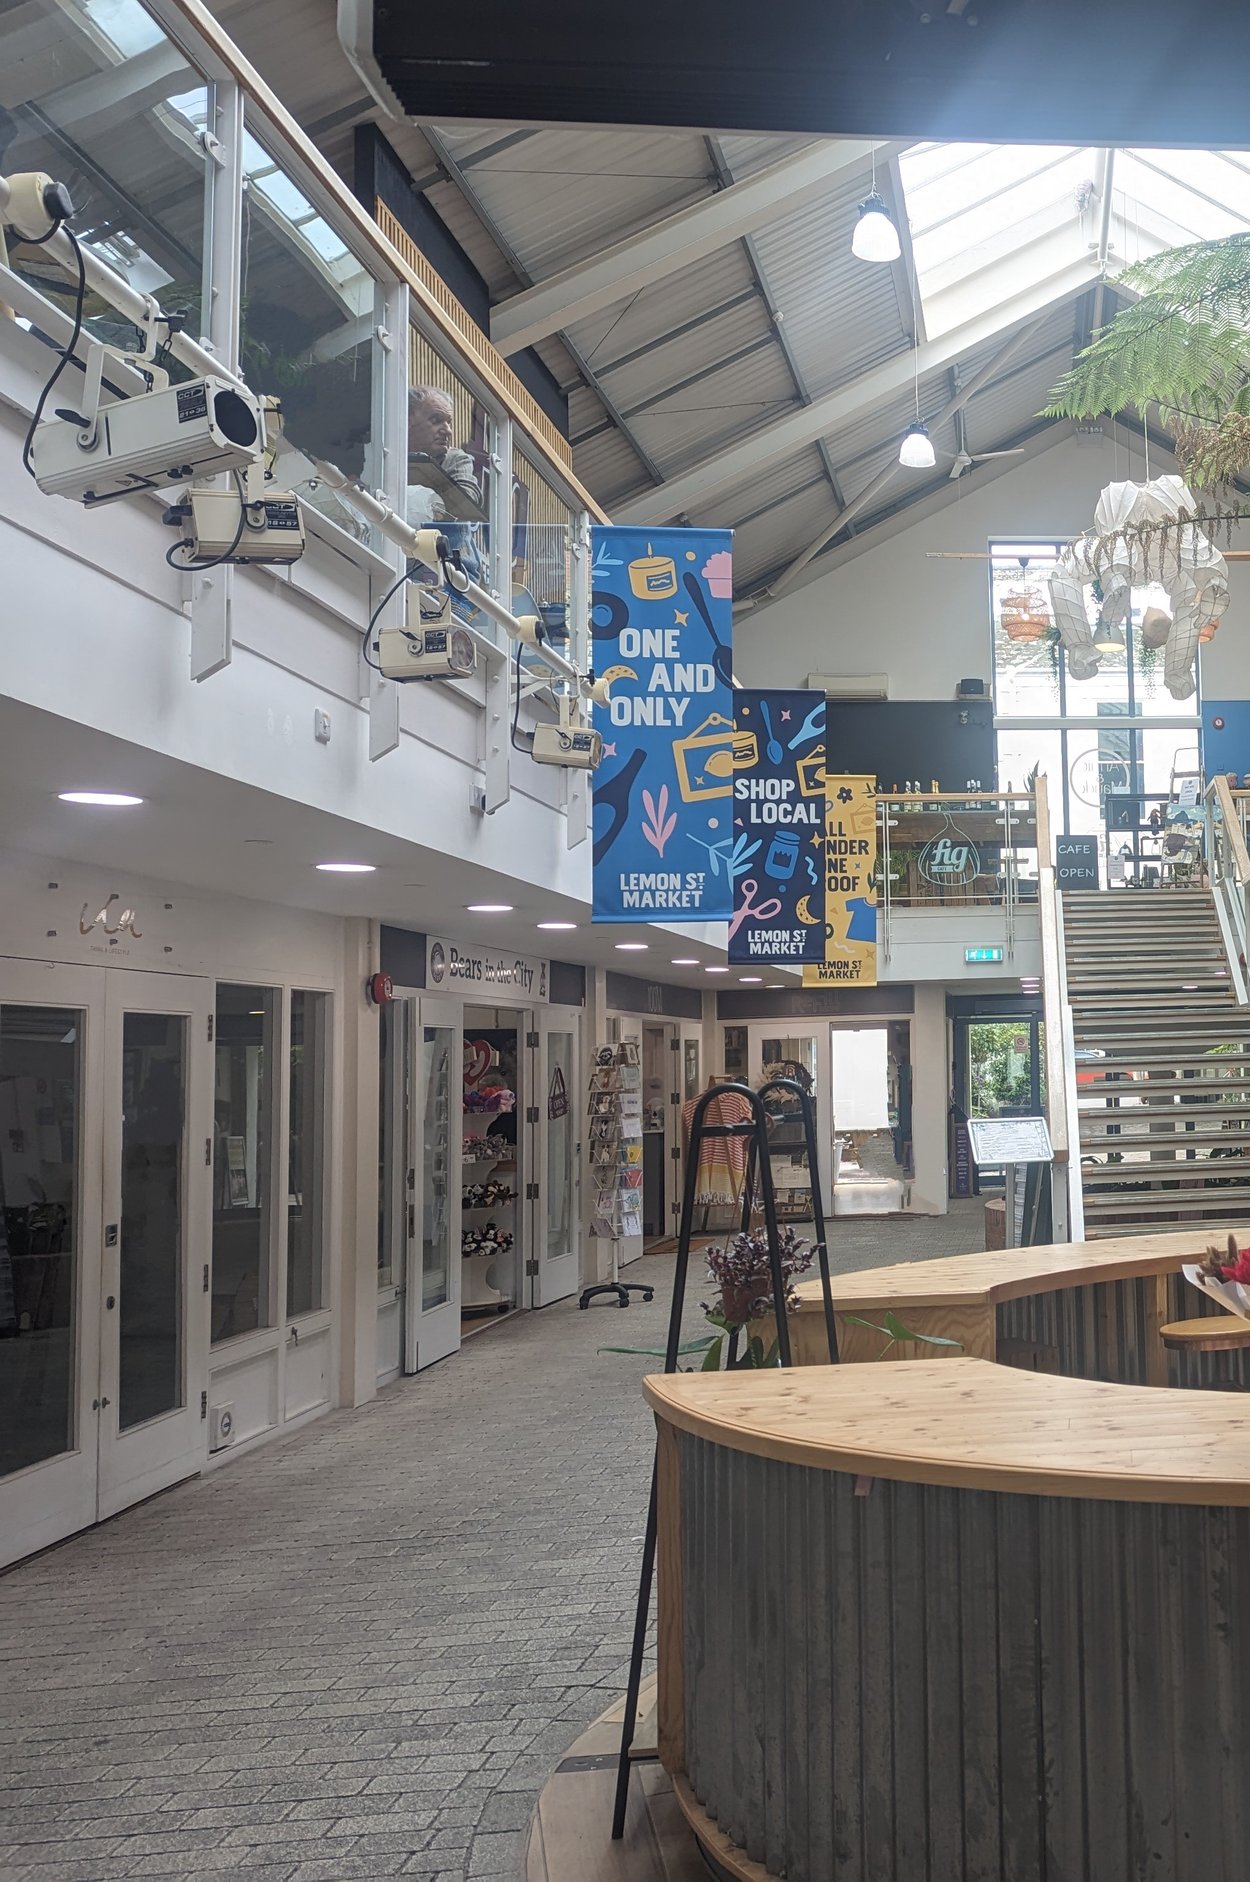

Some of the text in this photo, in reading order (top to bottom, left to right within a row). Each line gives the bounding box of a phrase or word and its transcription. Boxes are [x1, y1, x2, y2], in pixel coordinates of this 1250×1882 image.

[619, 628, 680, 658] ONE
[648, 663, 715, 692] AND
[610, 697, 691, 727] ONLY
[734, 778, 796, 800] SHOP
[750, 802, 821, 824] LOCAL
[826, 839, 869, 856] NDER
[930, 838, 969, 873] fig
[1058, 845, 1091, 855] CAFE
[826, 857, 847, 874] NE
[1059, 868, 1095, 878] OPEN
[619, 873, 681, 892] LEMON
[826, 875, 860, 892] OOF
[622, 890, 703, 909] MARKET
[747, 930, 790, 943] LEMON
[749, 942, 805, 955] MARKET
[449, 947, 483, 981] Bears
[513, 960, 534, 994] City
[817, 960, 849, 970] LEMON
[818, 969, 861, 979] MARKET
